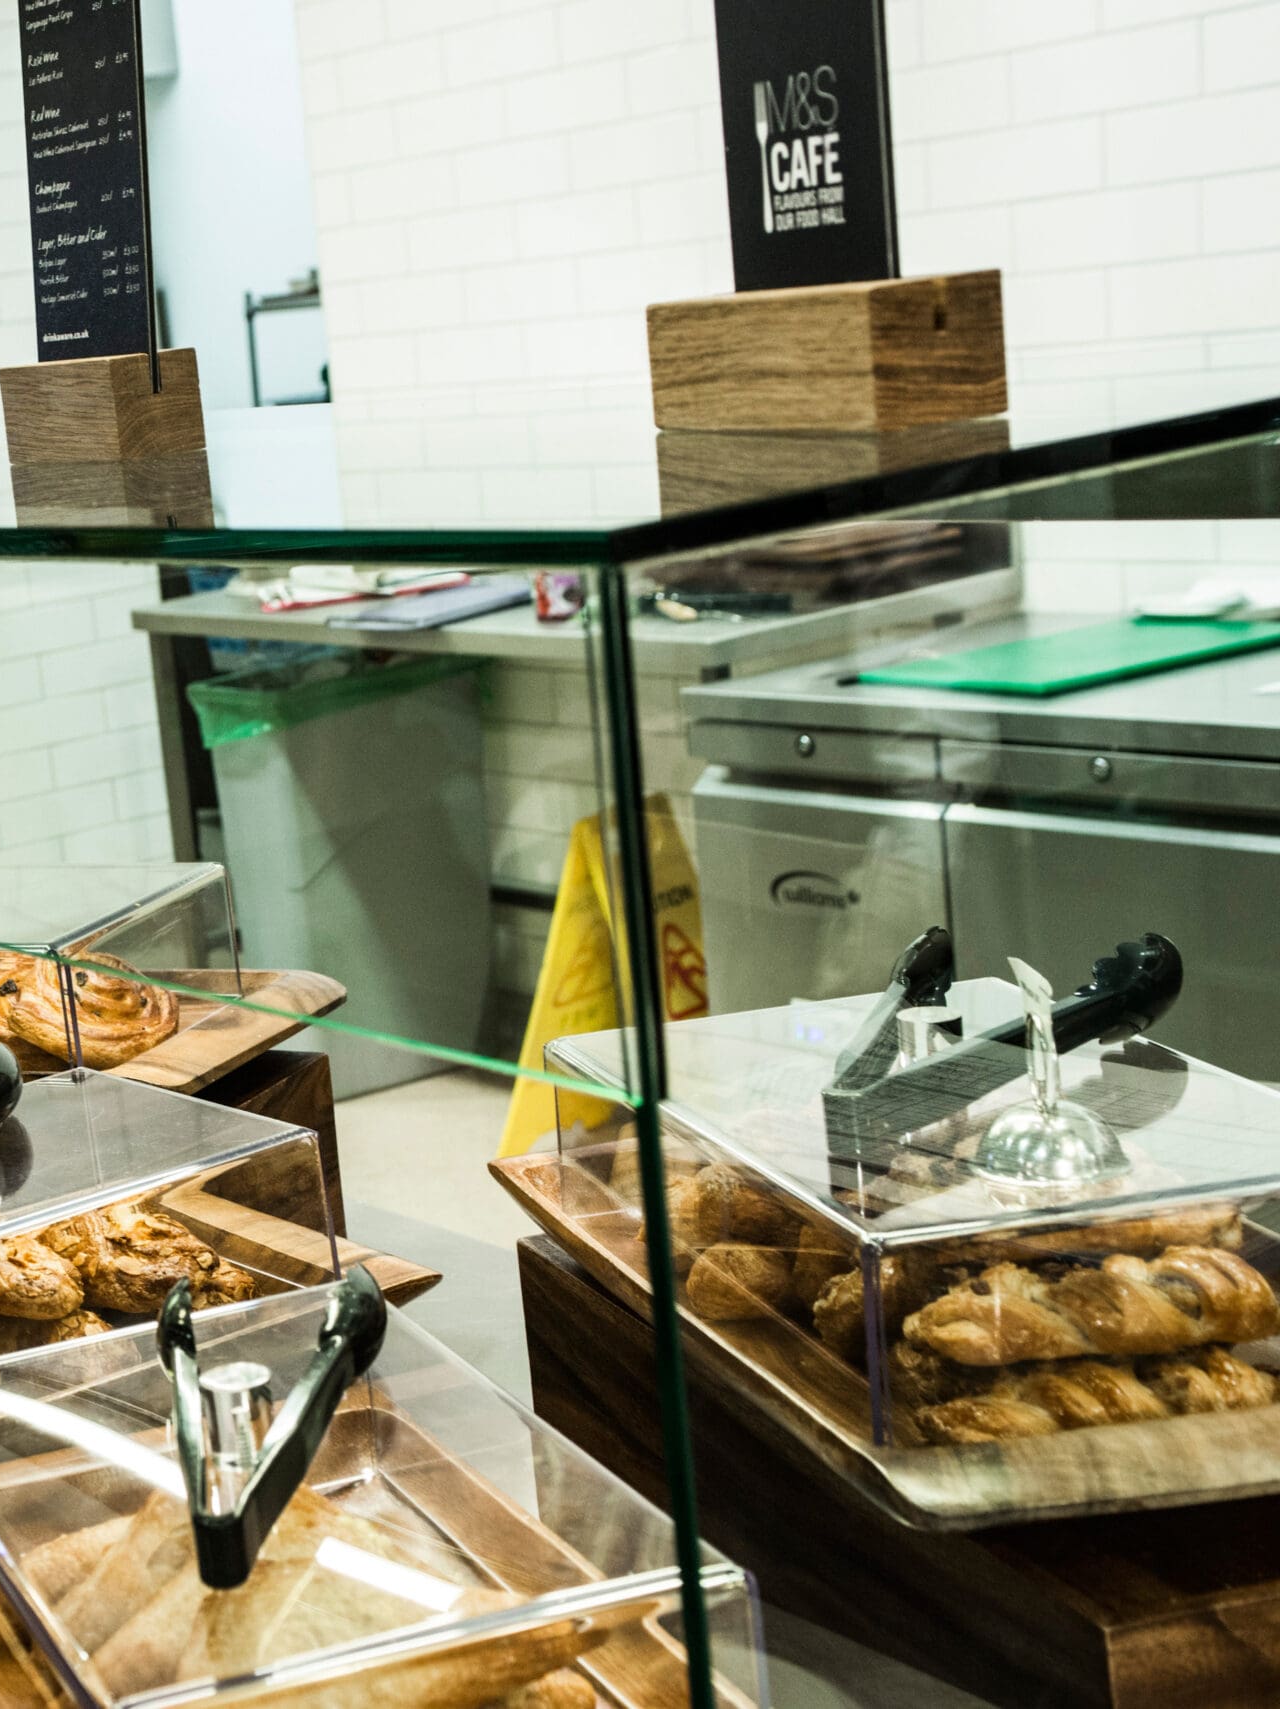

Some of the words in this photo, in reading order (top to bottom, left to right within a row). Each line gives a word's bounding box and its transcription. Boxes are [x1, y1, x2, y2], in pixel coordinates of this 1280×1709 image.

[765, 64, 840, 135] M&S
[30, 104, 45, 123] Red
[44, 107, 61, 120] Wine
[35, 180, 71, 199] Champagne
[775, 211, 795, 232] OUR
[57, 233, 77, 247] Bitter
[76, 227, 92, 245] and
[91, 224, 108, 241] Cider
